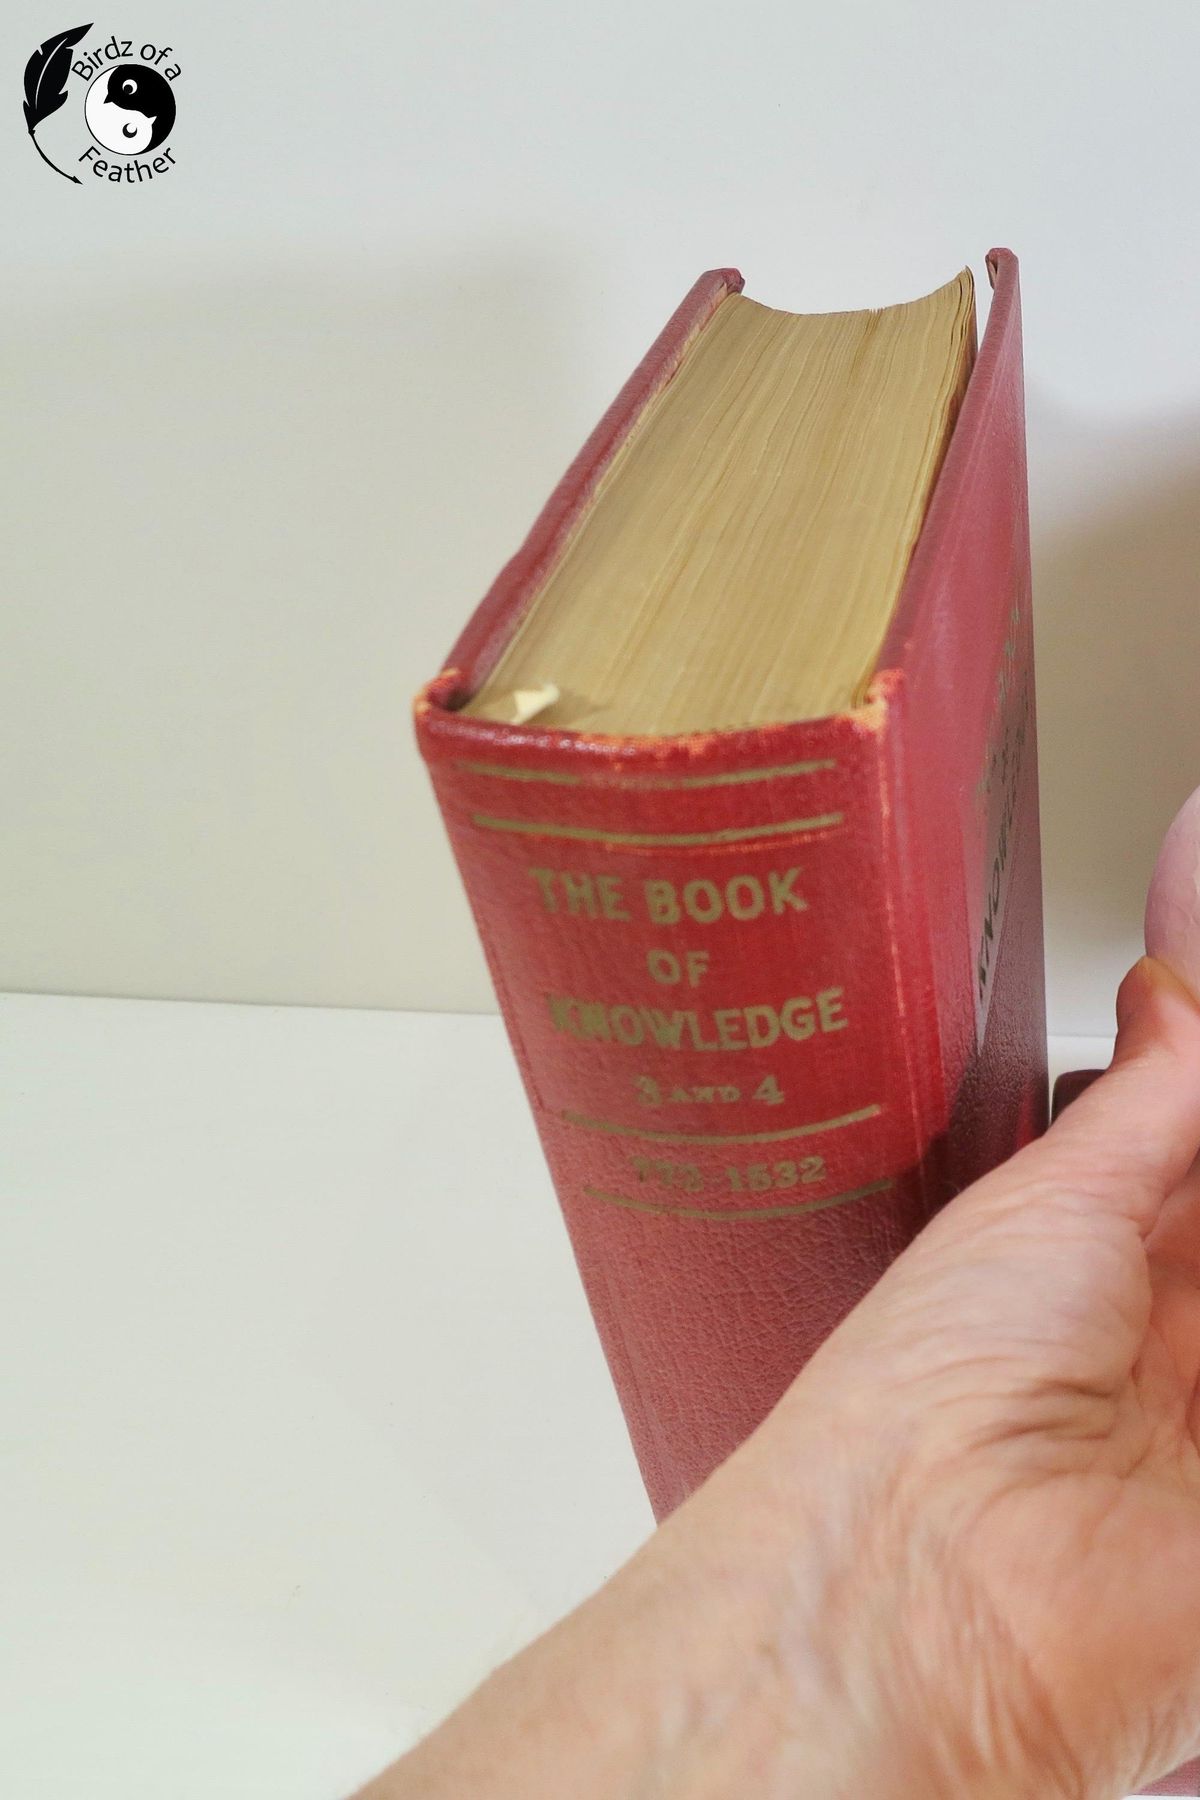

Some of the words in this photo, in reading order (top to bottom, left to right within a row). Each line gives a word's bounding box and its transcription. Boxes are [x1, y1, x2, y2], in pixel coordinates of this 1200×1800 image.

[529, 867, 631, 922] THE
[645, 866, 809, 925] BOOK
[646, 949, 709, 988] OF
[545, 985, 849, 1052] KNOWLEDGE
[633, 1073, 662, 1106] 3
[670, 1085, 742, 1103] AND
[752, 1074, 785, 1106] 4
